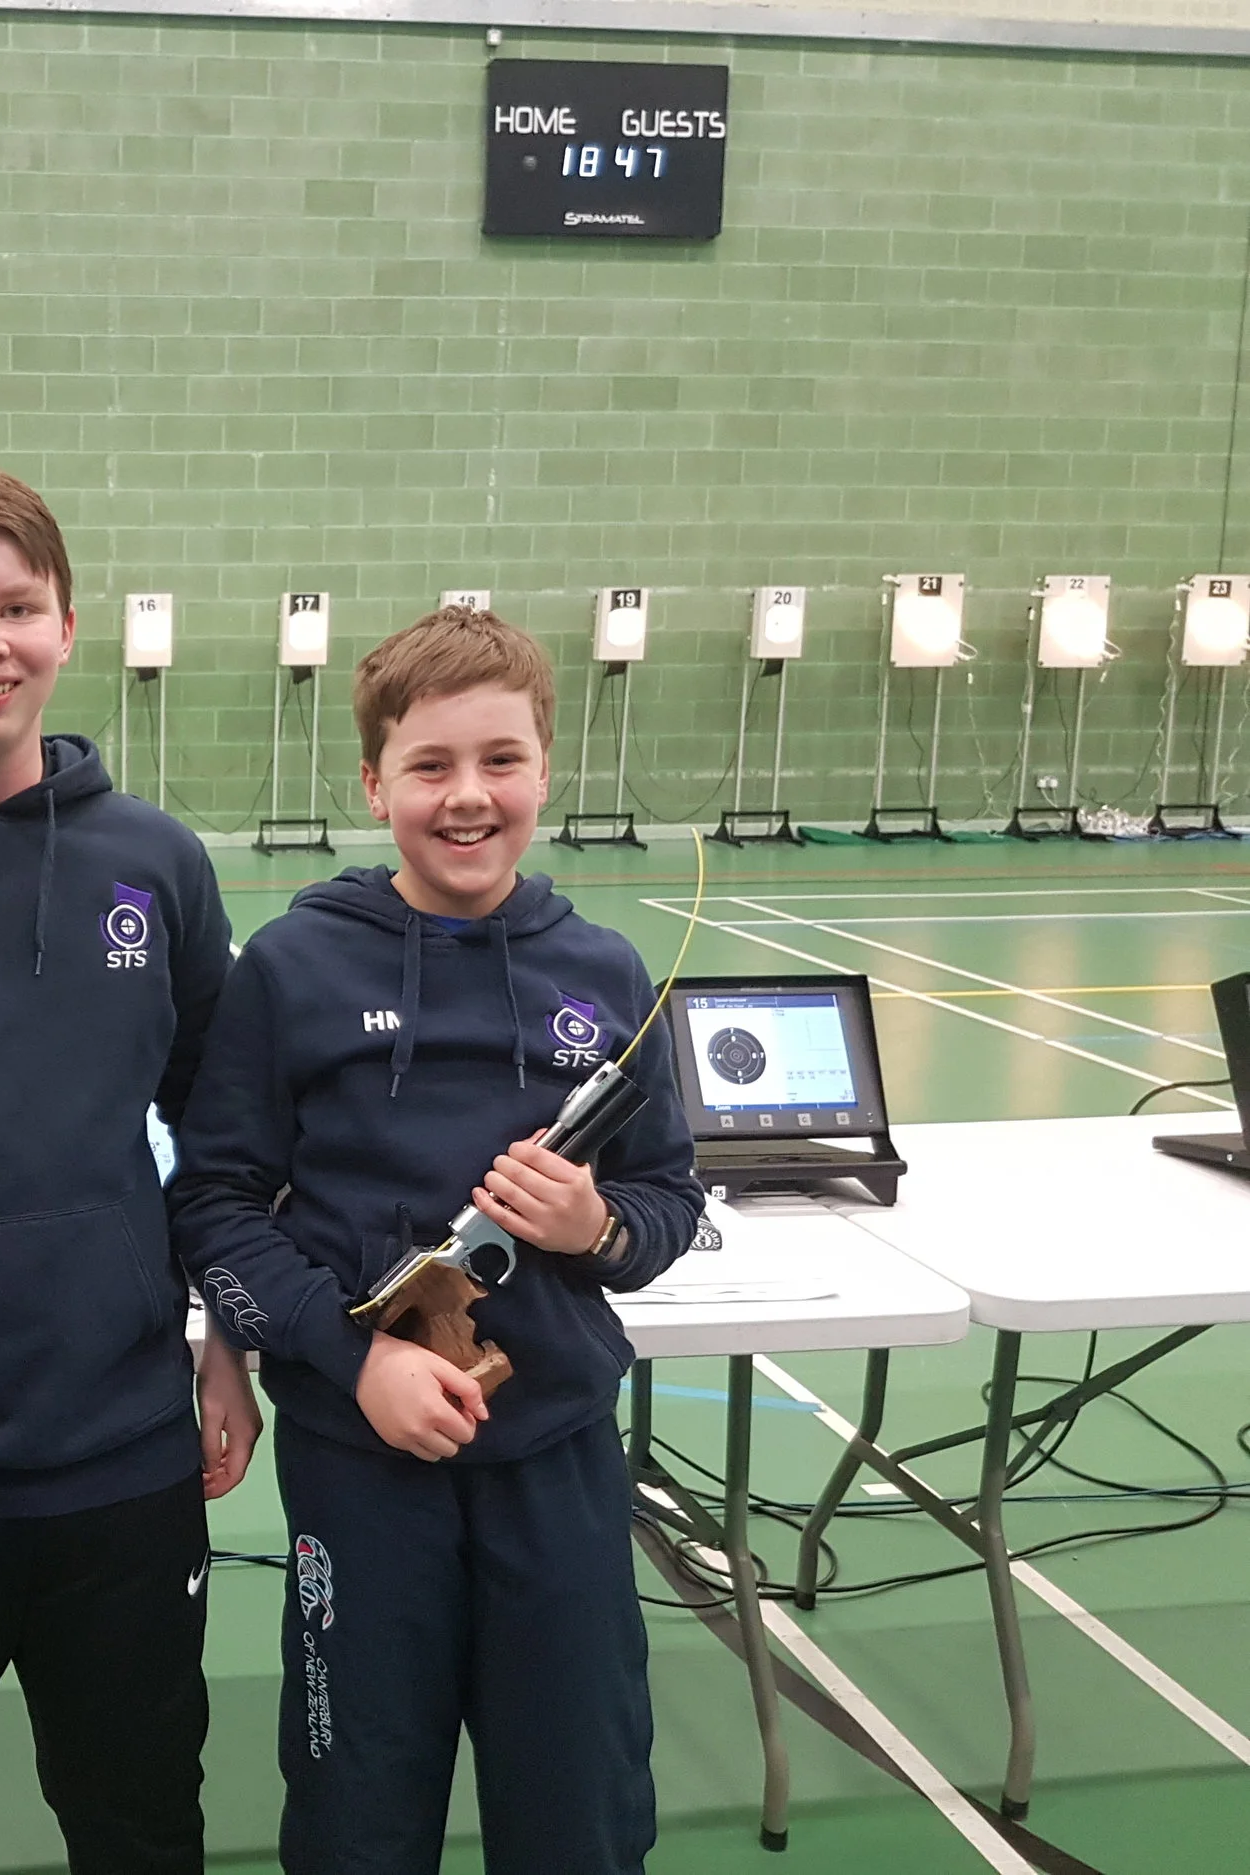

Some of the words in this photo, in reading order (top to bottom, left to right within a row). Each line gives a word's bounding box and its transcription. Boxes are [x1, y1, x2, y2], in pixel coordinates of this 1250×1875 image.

[495, 105, 576, 135] HOME
[621, 109, 726, 138] GUESTS
[561, 146, 600, 177] 18
[563, 211, 645, 225] STRAMATEL
[922, 577, 939, 590] 21
[1069, 578, 1085, 590] 22
[1212, 583, 1228, 595] 23
[294, 596, 316, 612] 17
[616, 592, 636, 607] 19
[774, 591, 792, 605] 20
[138, 599, 156, 613] 16
[106, 949, 147, 969] STS
[692, 997, 709, 1009] 15
[552, 1049, 599, 1067] STS
[713, 1189, 724, 1198] 25
[303, 1631, 316, 1657] OF
[305, 1654, 317, 1693] NEW
[316, 1657, 332, 1752] CANTERBURY
[307, 1689, 322, 1759] ZEALAND
